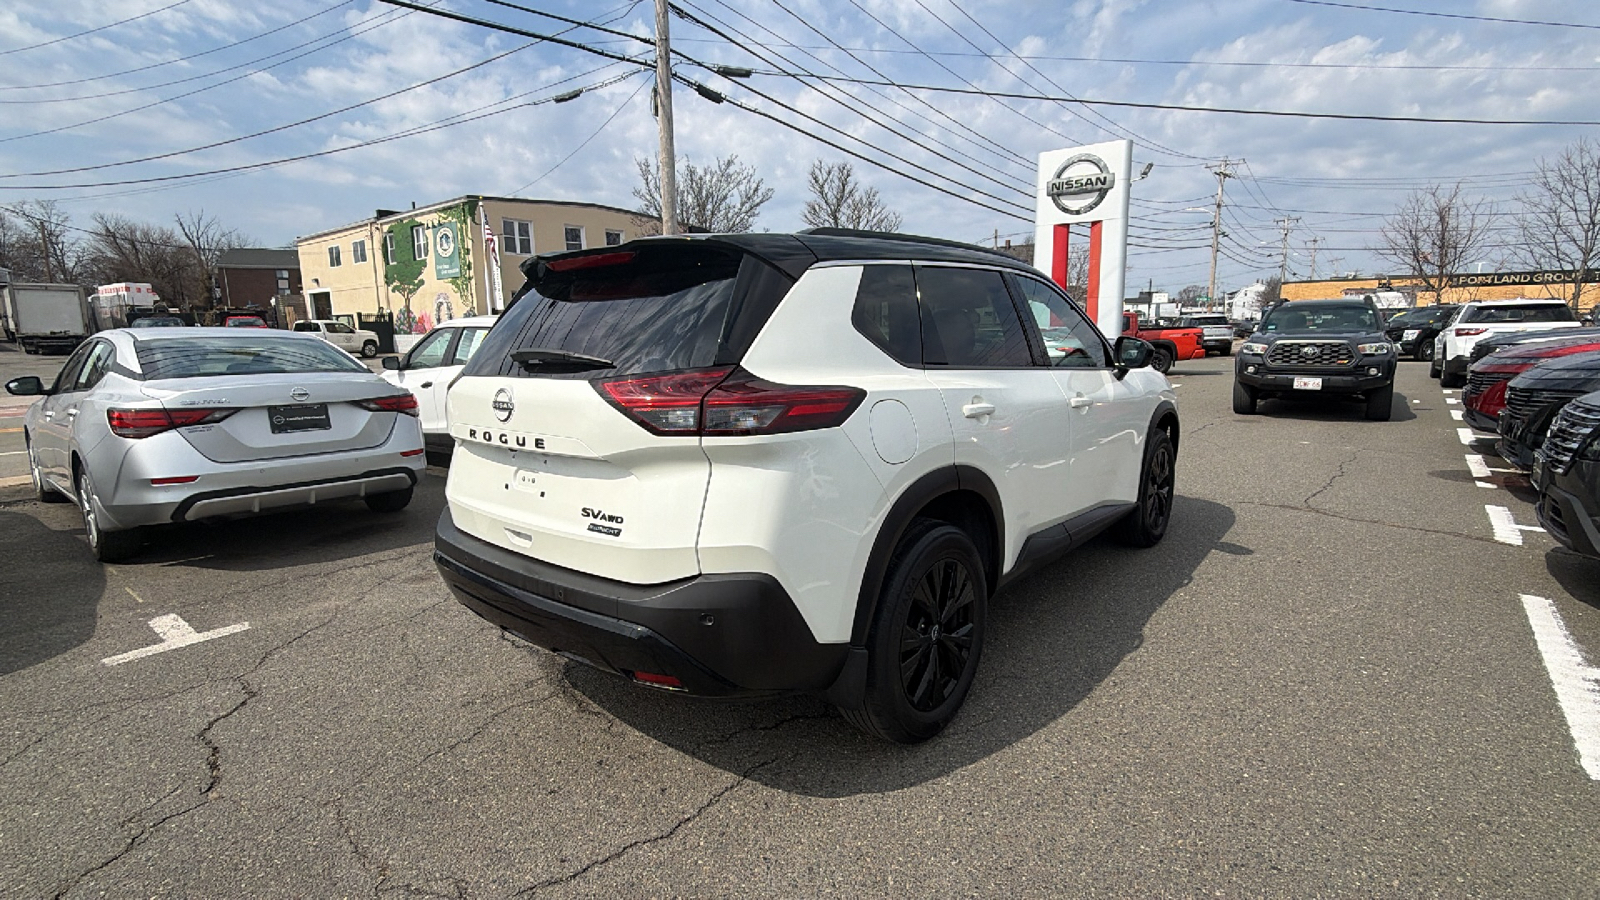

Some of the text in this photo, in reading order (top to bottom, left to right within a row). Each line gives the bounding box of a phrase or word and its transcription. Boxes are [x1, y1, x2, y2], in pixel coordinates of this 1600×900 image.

[1052, 176, 1107, 192] NISSAN
[1460, 271, 1582, 284] PORTLAND GROU
[469, 429, 545, 449] ROGUE
[581, 507, 624, 524] SV AWD
